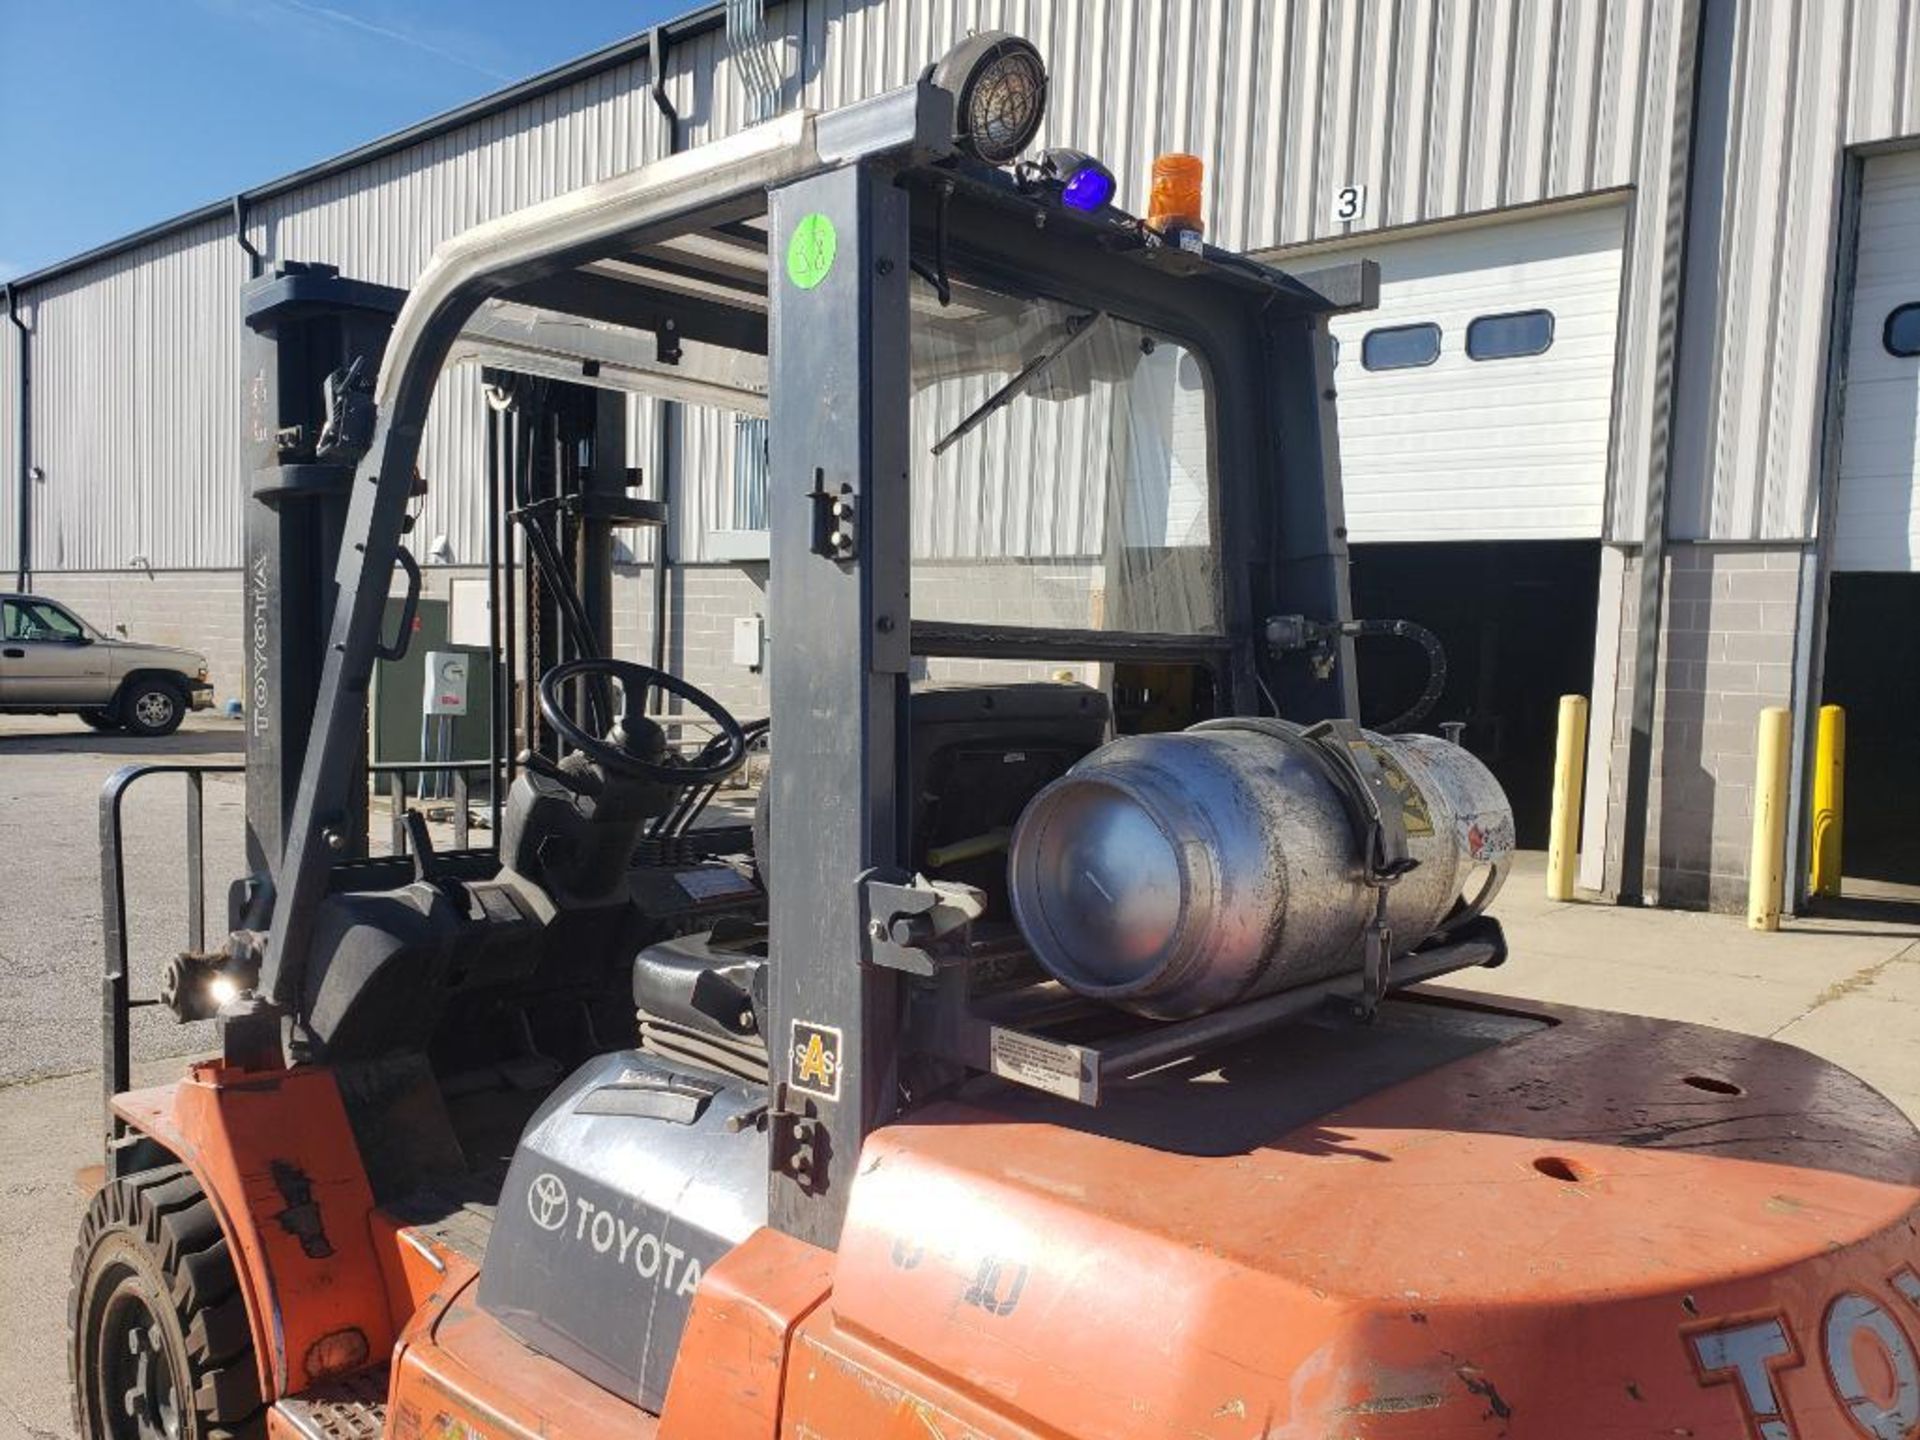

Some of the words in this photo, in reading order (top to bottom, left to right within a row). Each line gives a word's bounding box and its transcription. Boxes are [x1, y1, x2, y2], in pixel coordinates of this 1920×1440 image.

[1338, 188, 1358, 219] 3
[253, 554, 269, 737] TOYOTA
[576, 1197, 702, 1297] TOYOTA
[1690, 1268, 1920, 1440] TO
